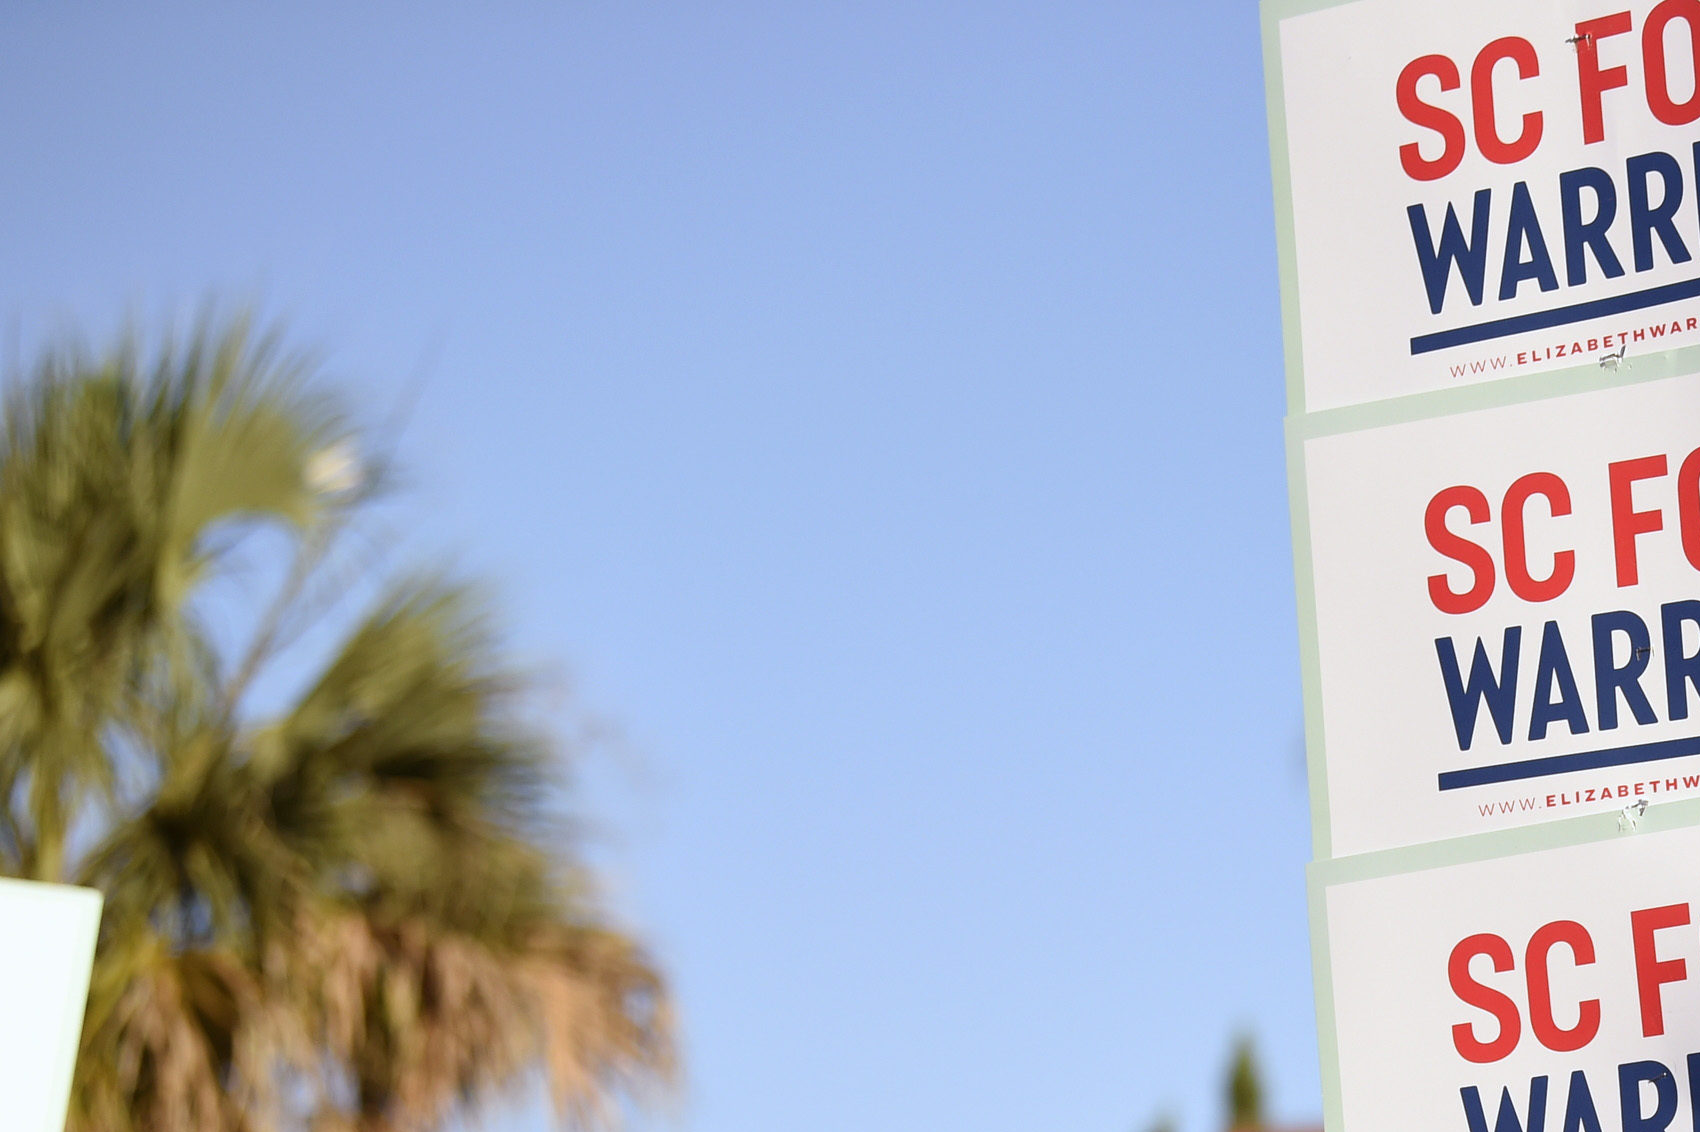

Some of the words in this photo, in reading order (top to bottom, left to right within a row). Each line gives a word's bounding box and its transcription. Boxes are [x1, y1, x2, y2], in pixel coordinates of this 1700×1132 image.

[1396, 36, 1543, 182] SC
[1424, 472, 1576, 615] SC
[1447, 919, 1601, 1064] SC
